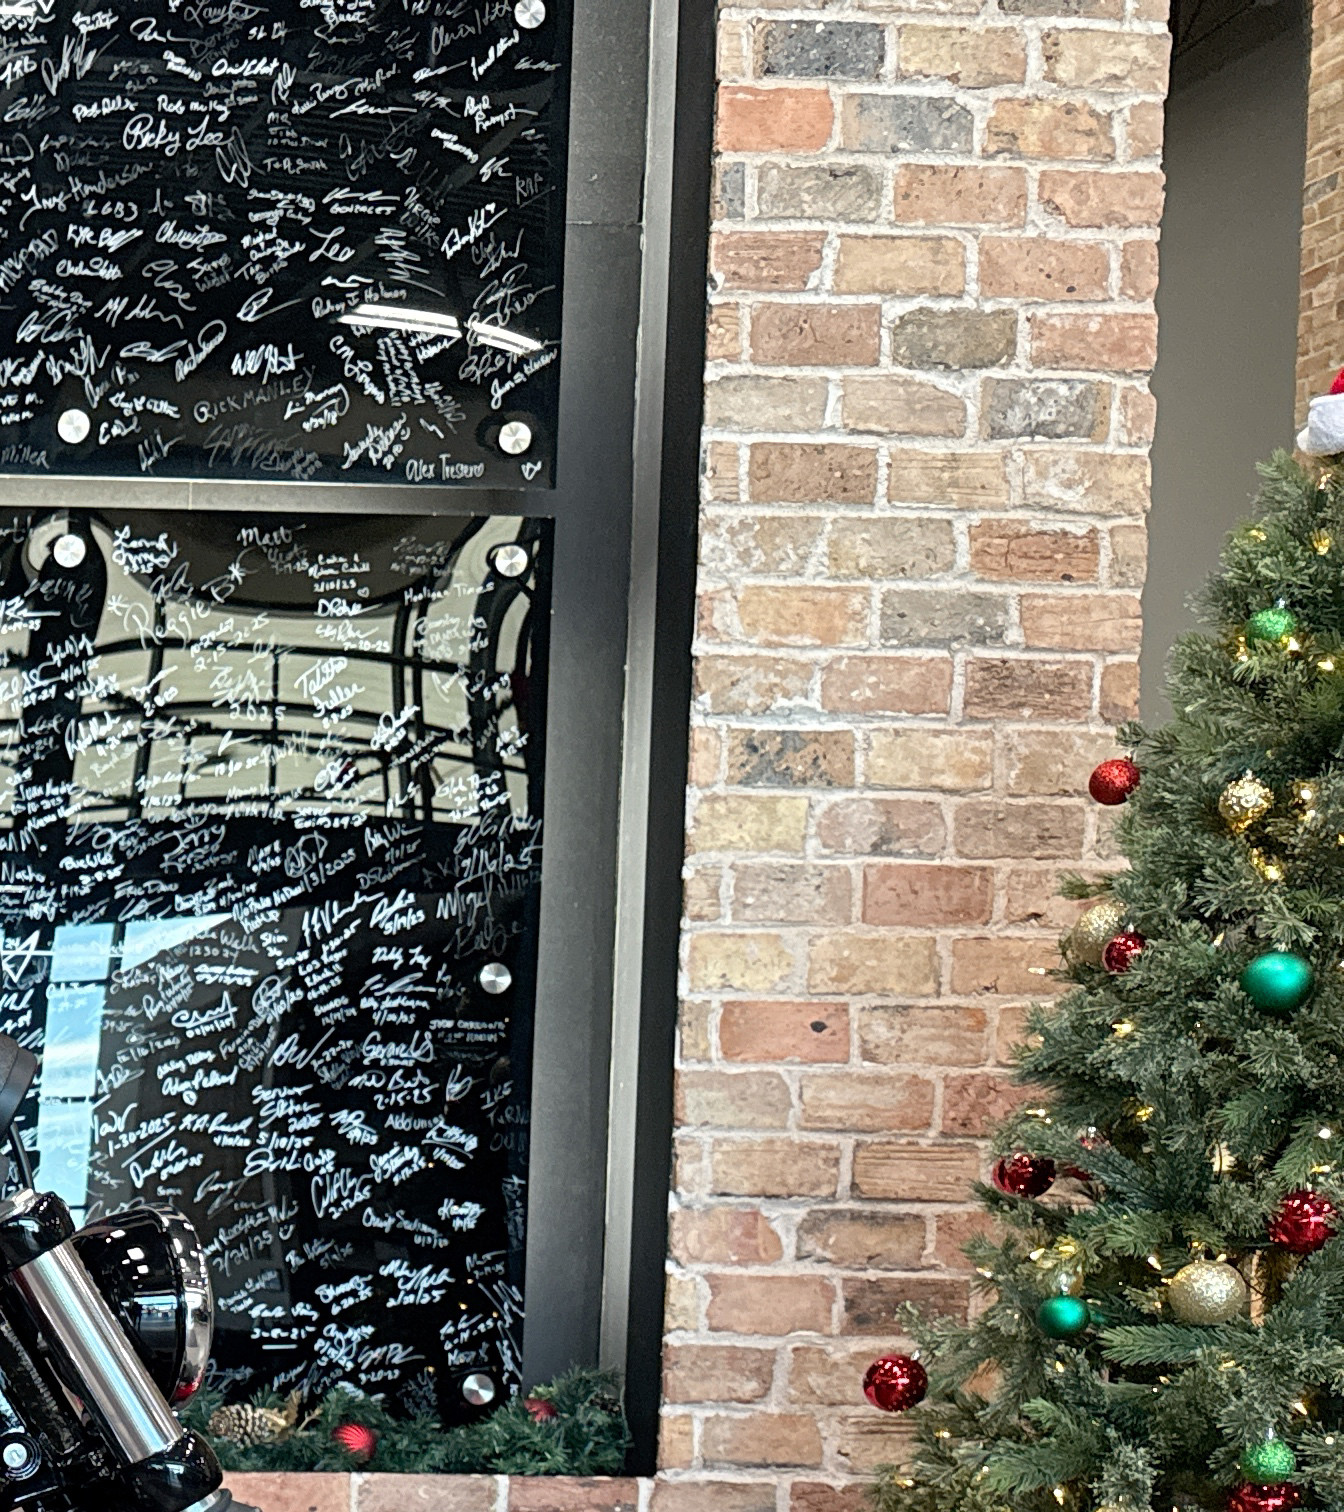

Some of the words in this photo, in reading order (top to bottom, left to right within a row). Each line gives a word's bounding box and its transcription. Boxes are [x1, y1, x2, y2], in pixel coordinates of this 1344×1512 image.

[186, 115, 233, 150] Lee
[308, 226, 355, 262] Lee
[124, 600, 212, 651] Reggie
[230, 703, 287, 721] 2025
[461, 841, 532, 877] 9/16/25
